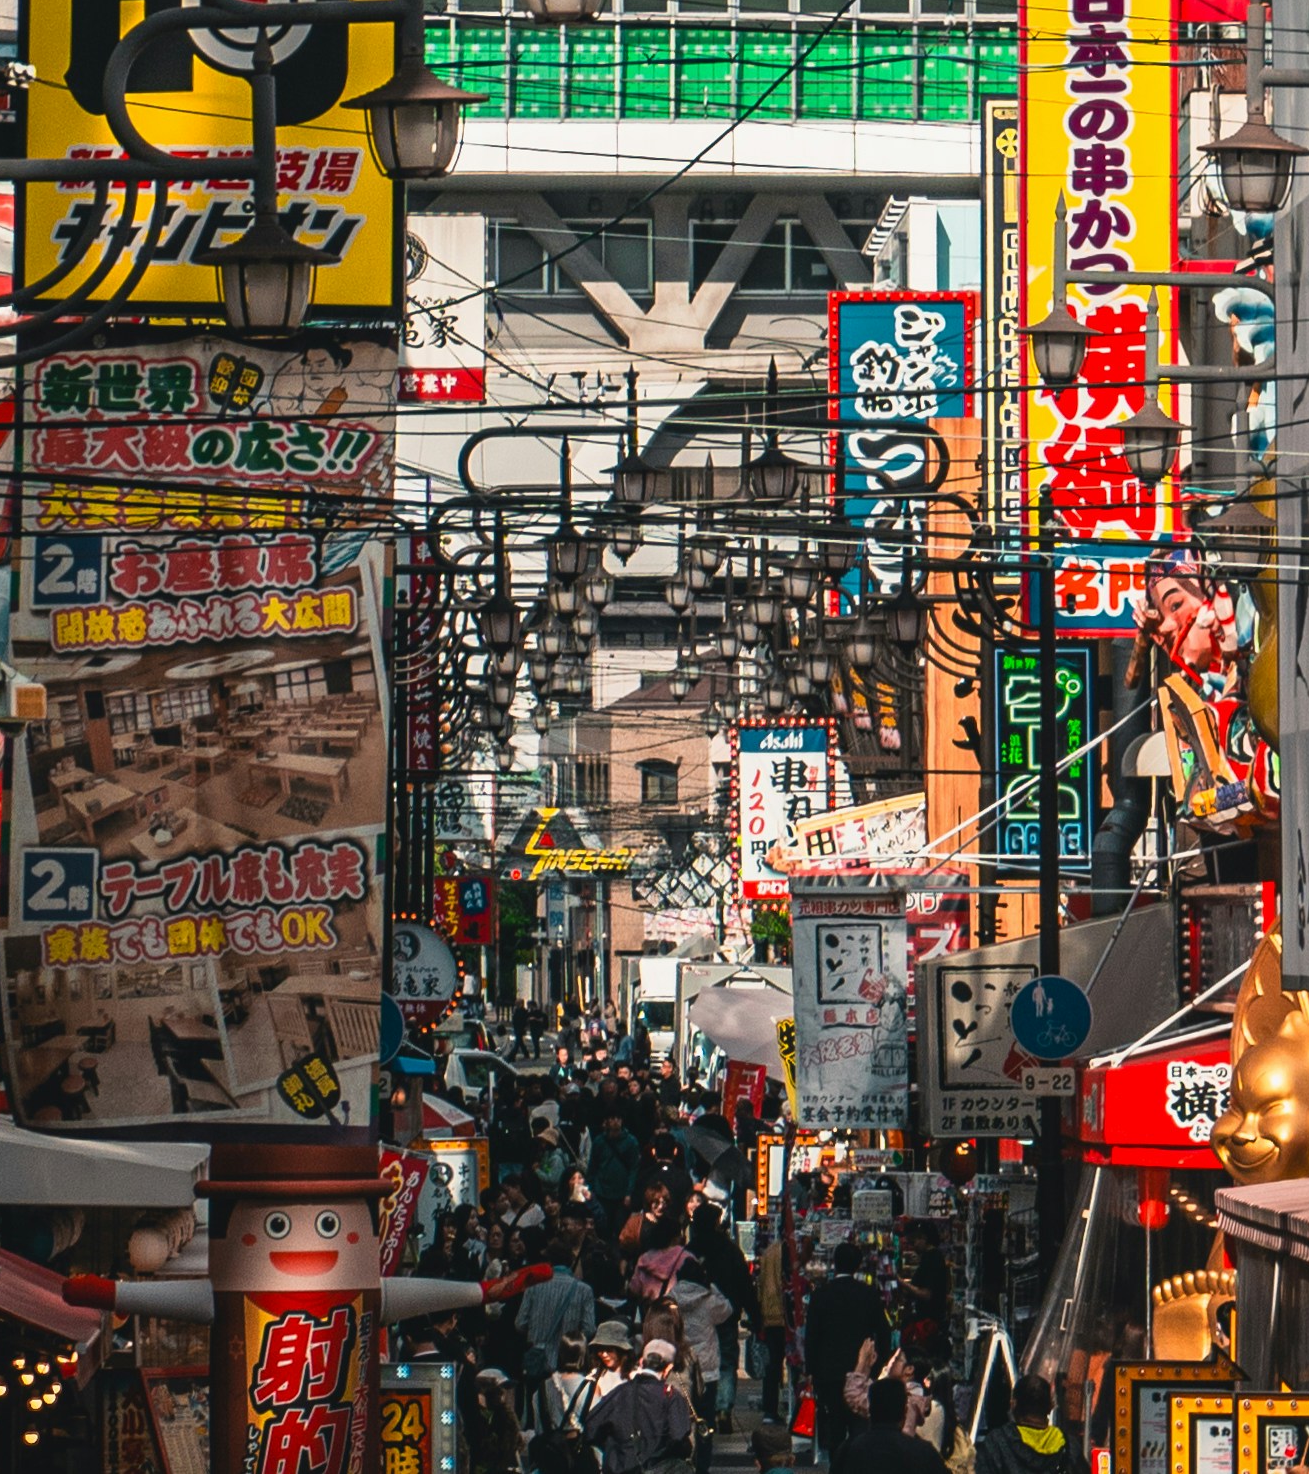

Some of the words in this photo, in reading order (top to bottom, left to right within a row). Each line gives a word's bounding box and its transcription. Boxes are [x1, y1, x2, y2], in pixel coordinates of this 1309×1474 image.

[40, 360, 196, 414] 新世界
[1045, 304, 1160, 542] 横綱
[114, 537, 316, 596] お座敷席
[56, 590, 352, 646] 開放感あふれる大広間
[759, 731, 804, 751] Asahi
[1006, 823, 1082, 855] GAE
[102, 843, 364, 916] テーブル席も充実
[47, 906, 331, 964] 家族でも団体でもOK
[1171, 1066, 1228, 1078] 日本一の
[802, 1105, 904, 1124] 宴会予約受付中
[1171, 1081, 1232, 1123] 横
[380, 1401, 426, 1442] 24
